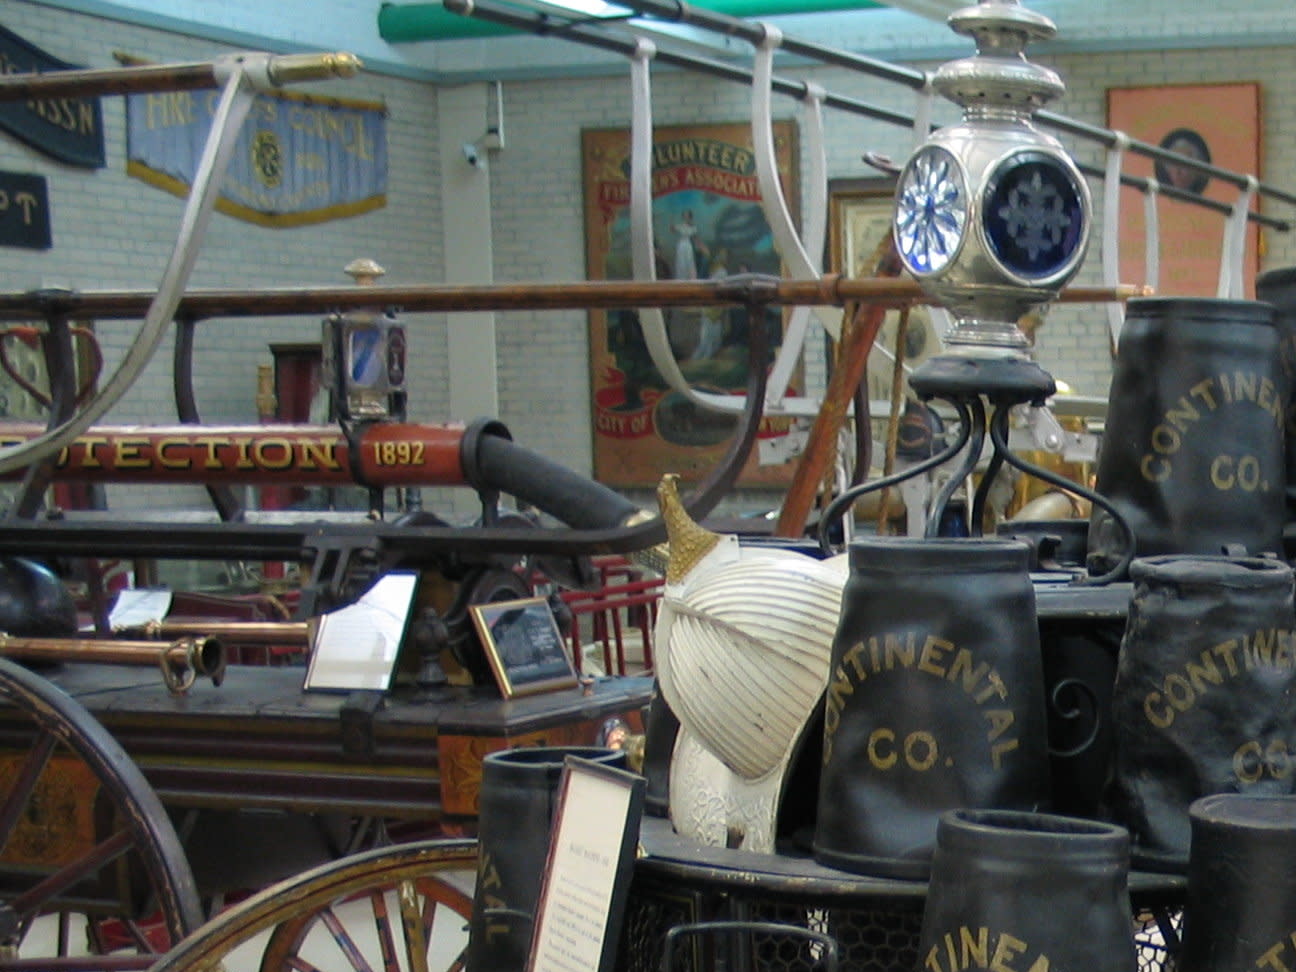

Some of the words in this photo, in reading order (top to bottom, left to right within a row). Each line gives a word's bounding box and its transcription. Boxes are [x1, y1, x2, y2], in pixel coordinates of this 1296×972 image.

[373, 440, 426, 466] 1892
[1210, 455, 1269, 492] CO.
[866, 726, 954, 772] CO.
